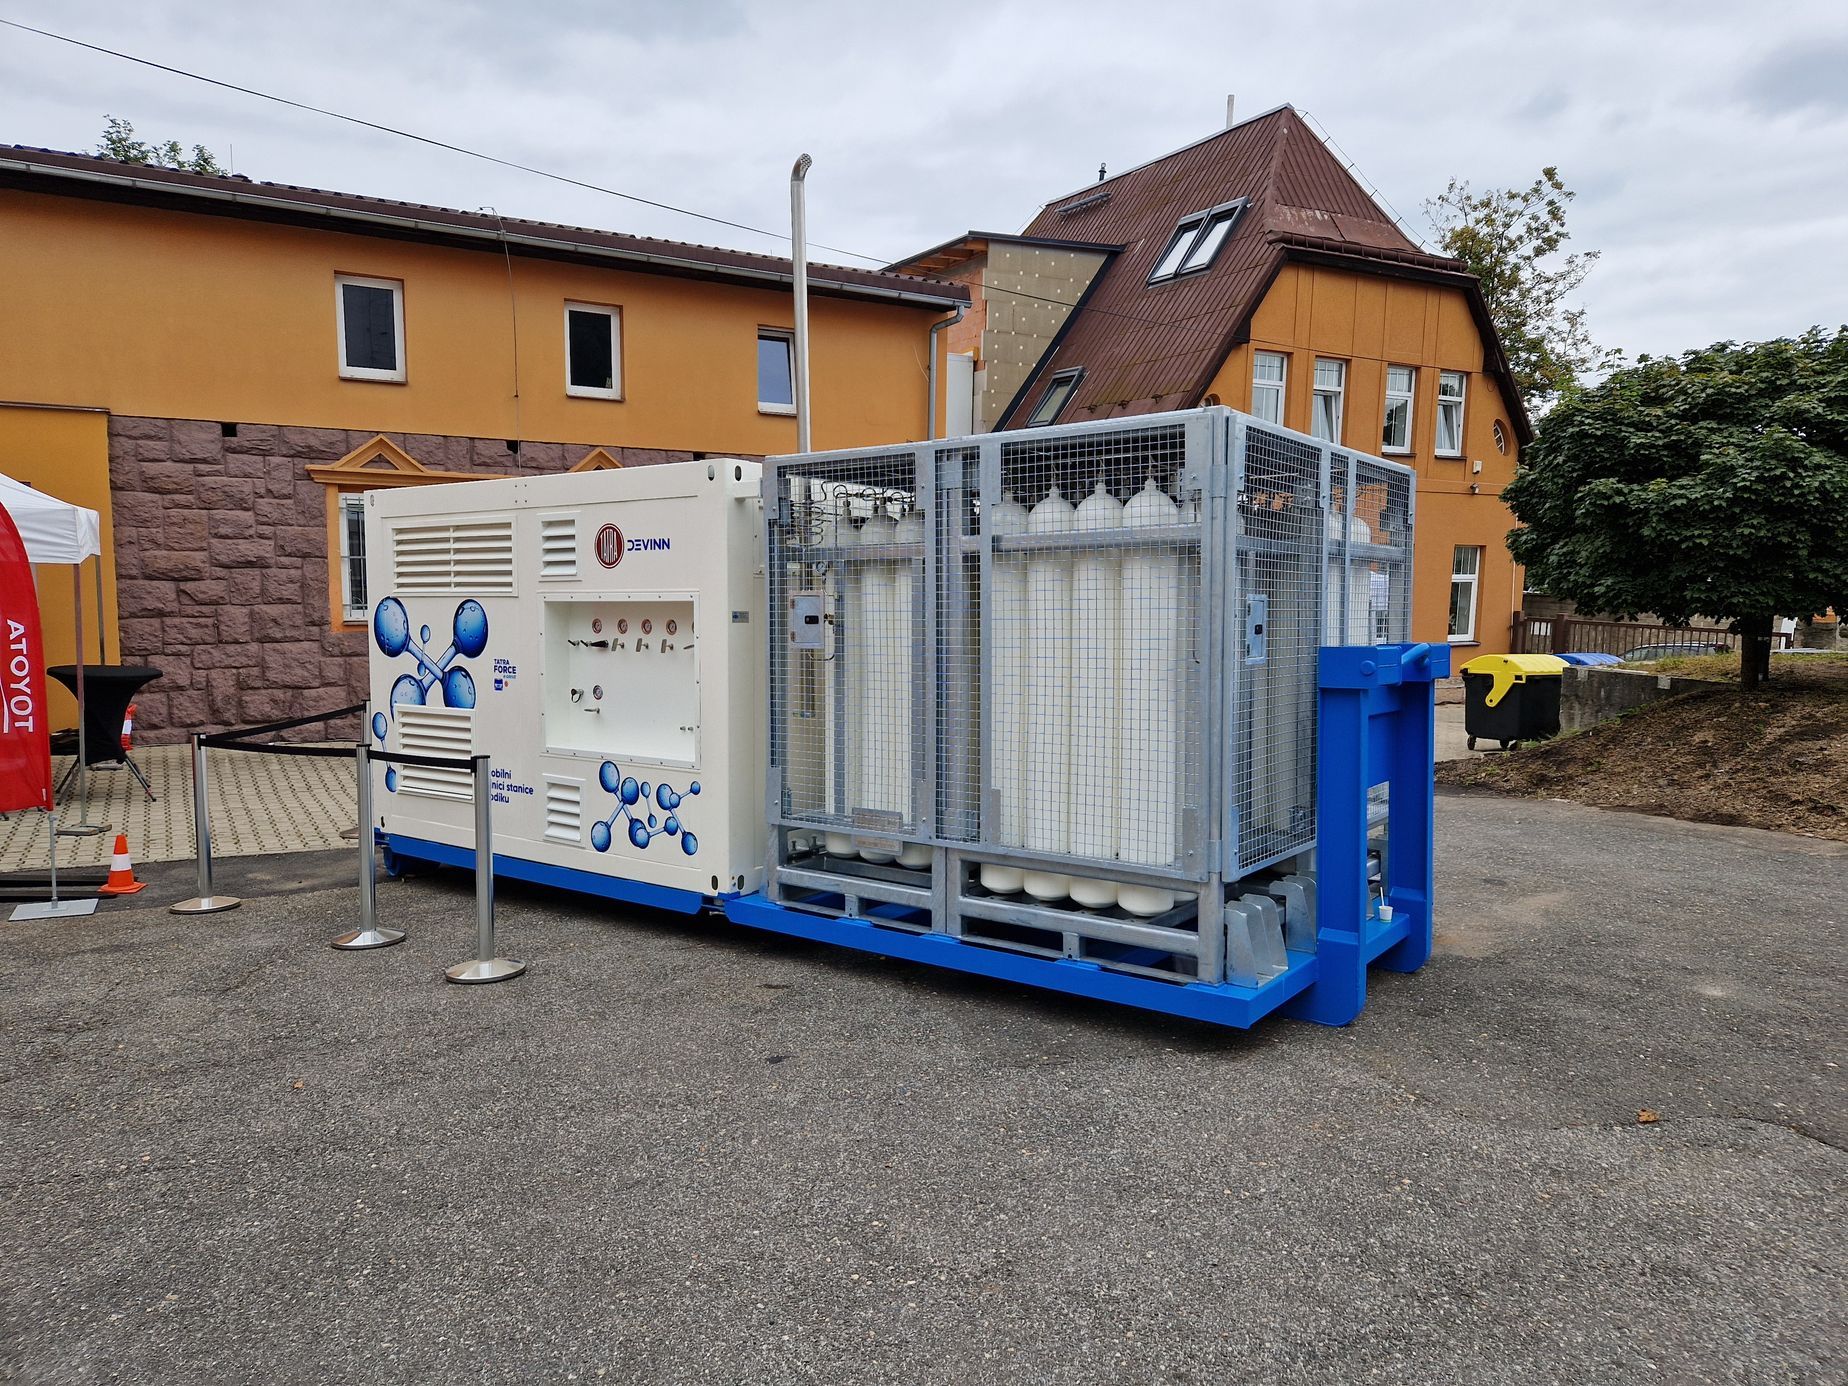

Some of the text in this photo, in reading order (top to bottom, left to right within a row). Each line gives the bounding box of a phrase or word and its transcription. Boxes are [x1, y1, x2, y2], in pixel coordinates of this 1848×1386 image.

[626, 537, 671, 552] DEVINN
[493, 665, 517, 674] FORCE
[490, 768, 512, 779] obilní
[506, 783, 534, 795] stanice
